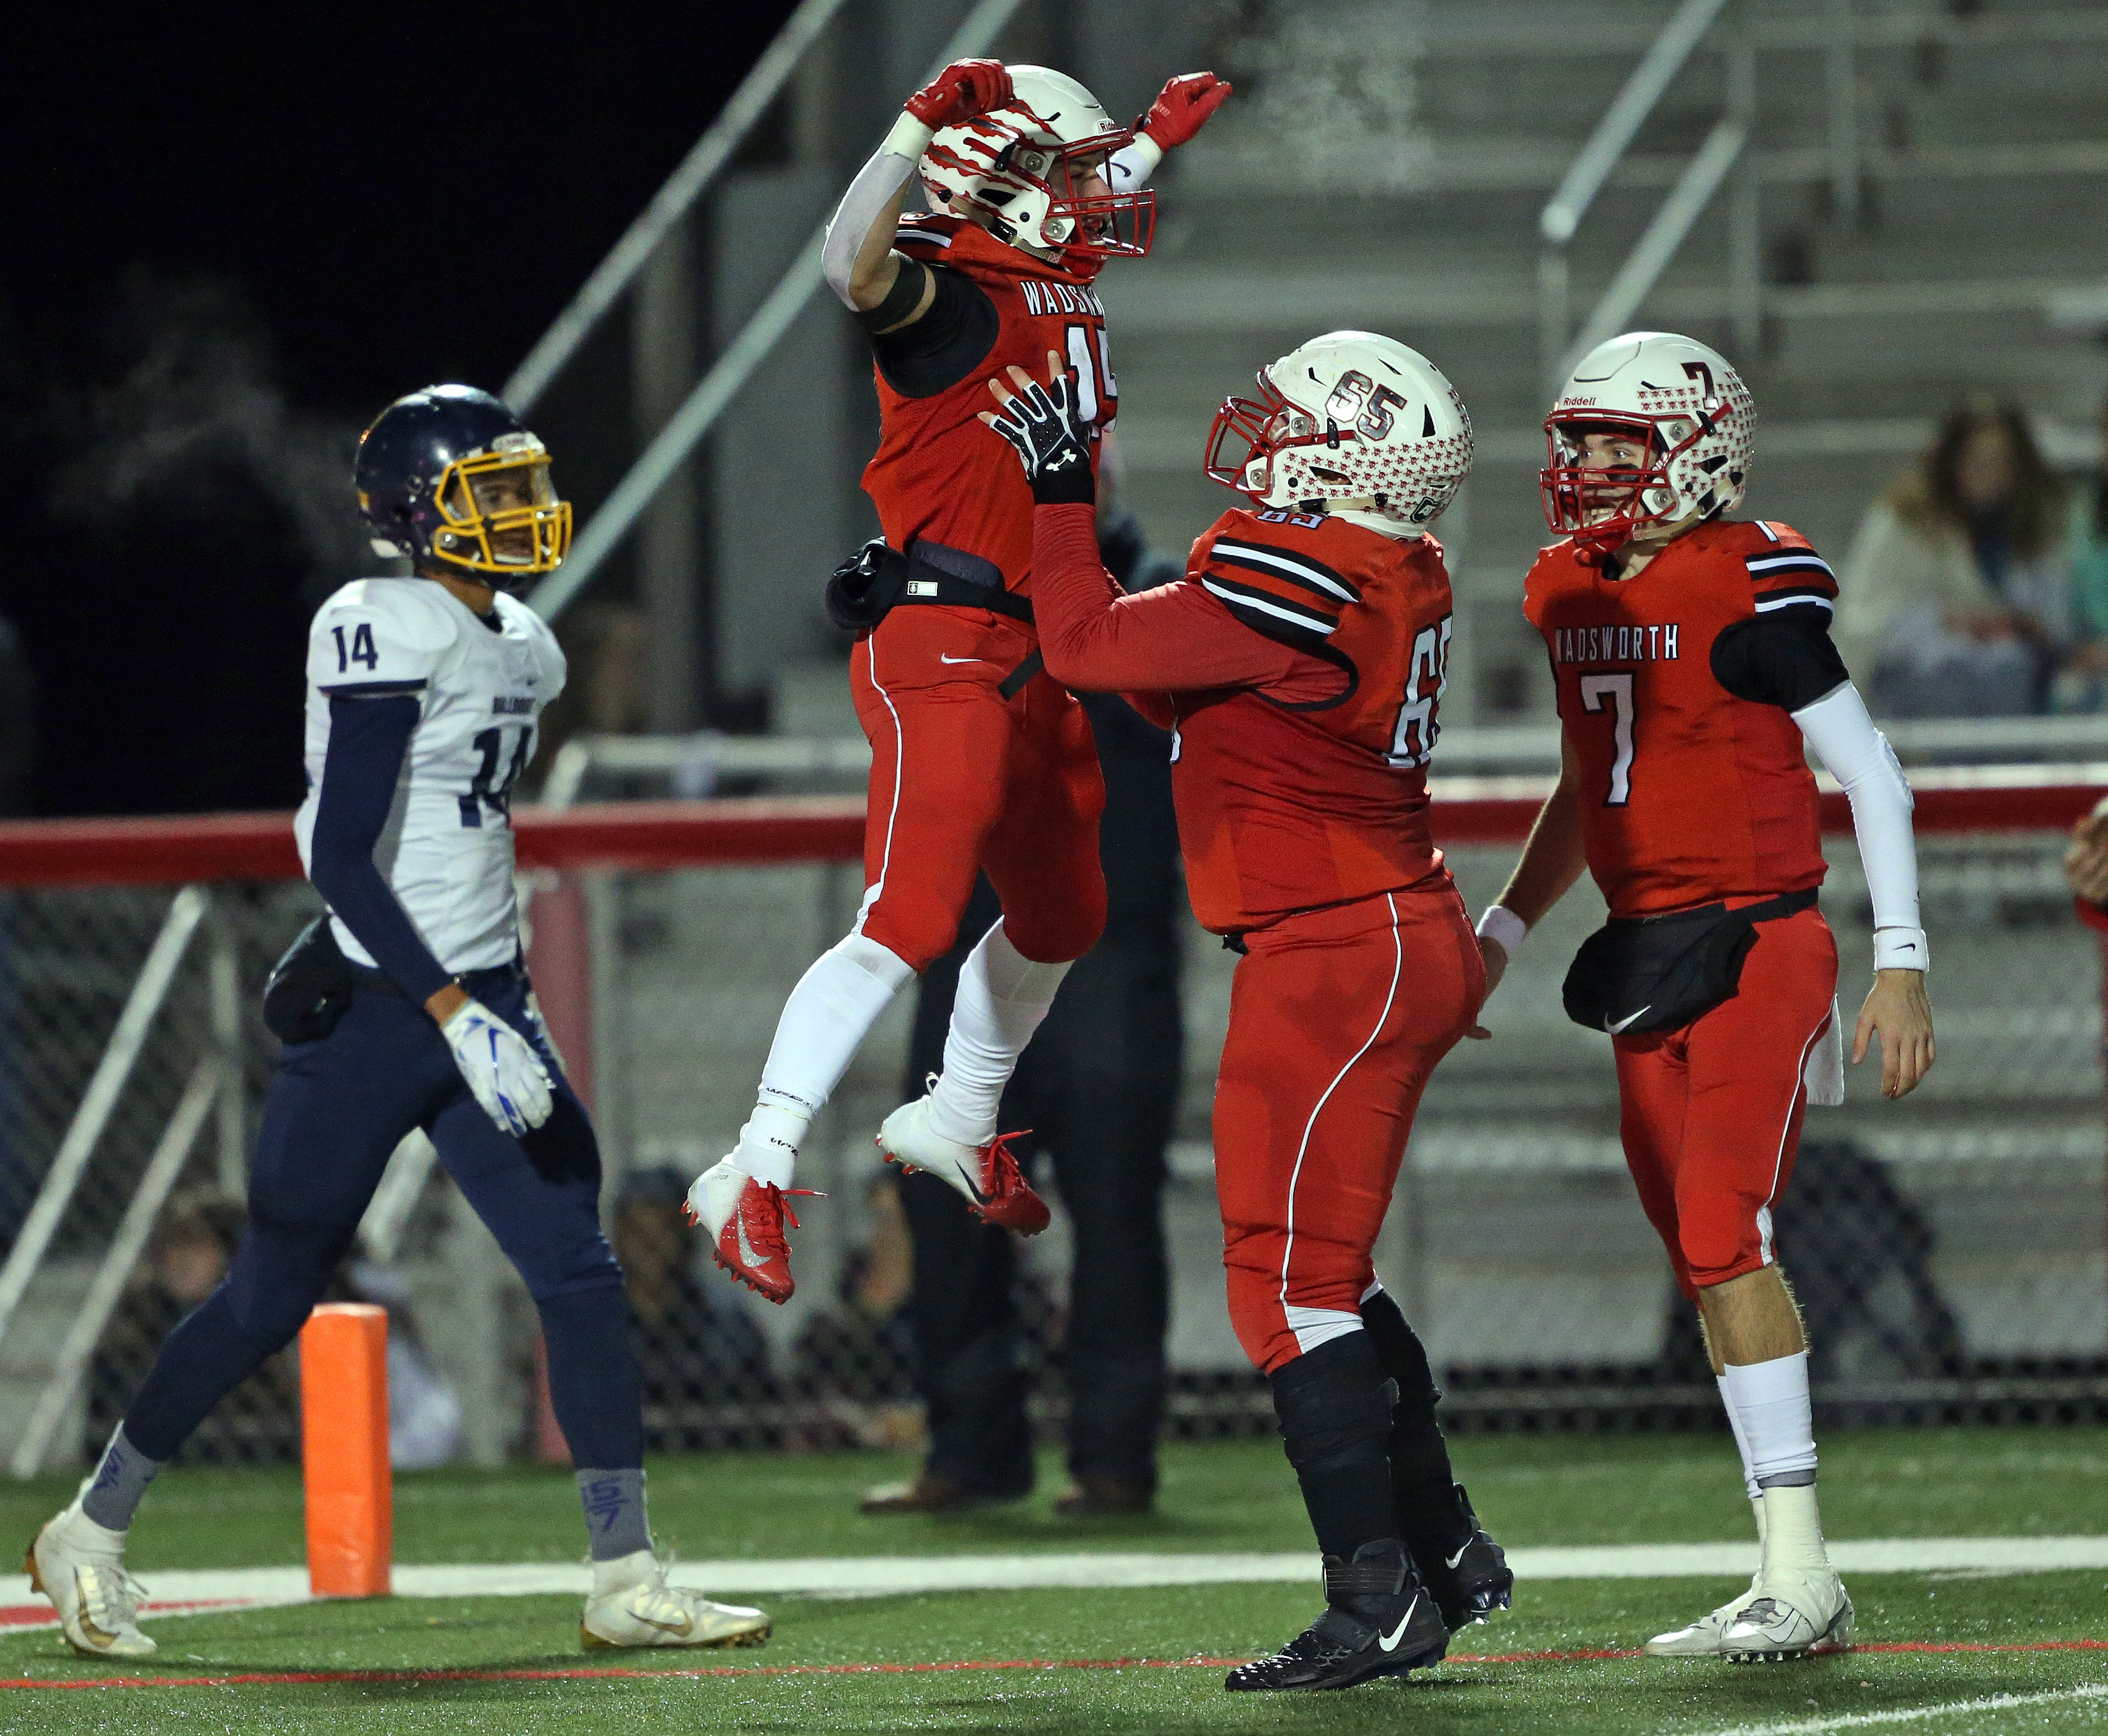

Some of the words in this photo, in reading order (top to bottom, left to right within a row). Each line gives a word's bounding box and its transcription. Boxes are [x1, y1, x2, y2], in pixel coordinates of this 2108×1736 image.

[1325, 370, 1408, 442] 65
[1563, 397, 1597, 406] Riddell
[1680, 362, 1720, 410] 7
[332, 622, 379, 673] 14
[1579, 670, 1638, 807] 7
